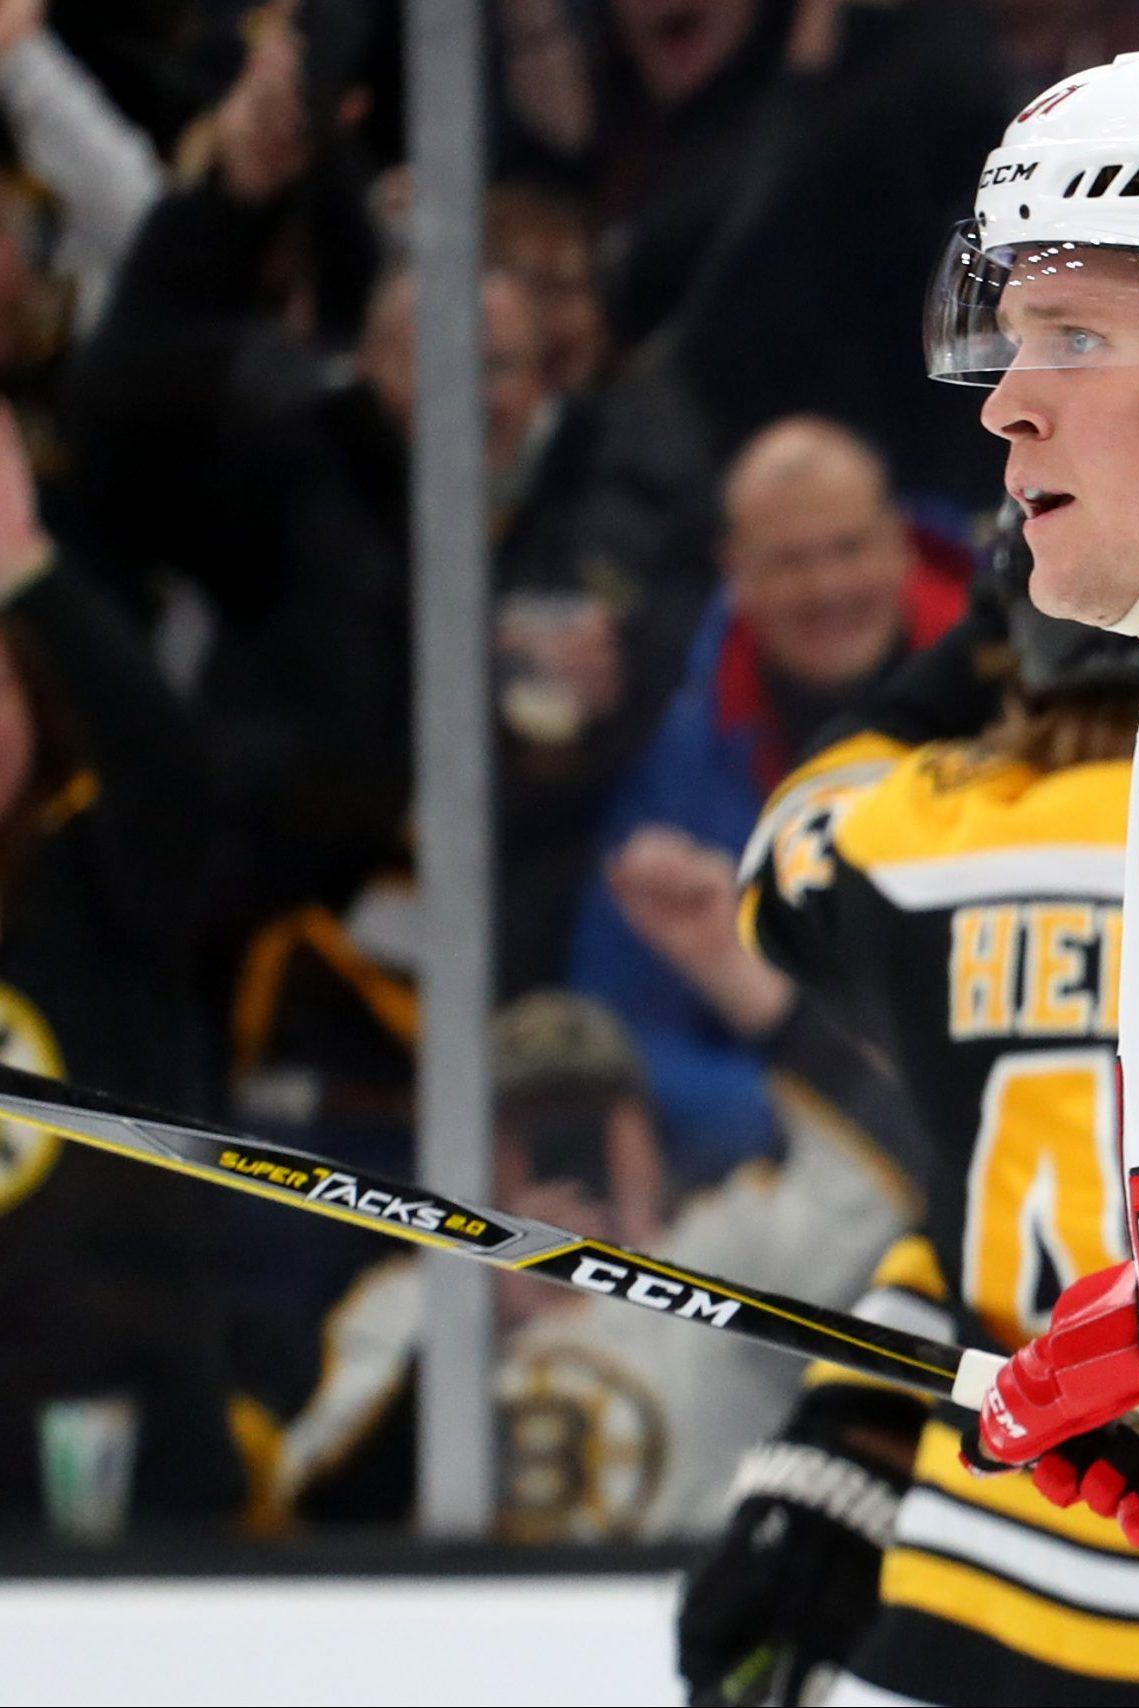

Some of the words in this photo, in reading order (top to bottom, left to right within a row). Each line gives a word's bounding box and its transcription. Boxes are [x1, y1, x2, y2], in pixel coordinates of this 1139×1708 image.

[979, 161, 1039, 190] CCM
[218, 1150, 309, 1189] SUPER
[303, 1167, 447, 1232] TACKS
[570, 1256, 742, 1328] CCM
